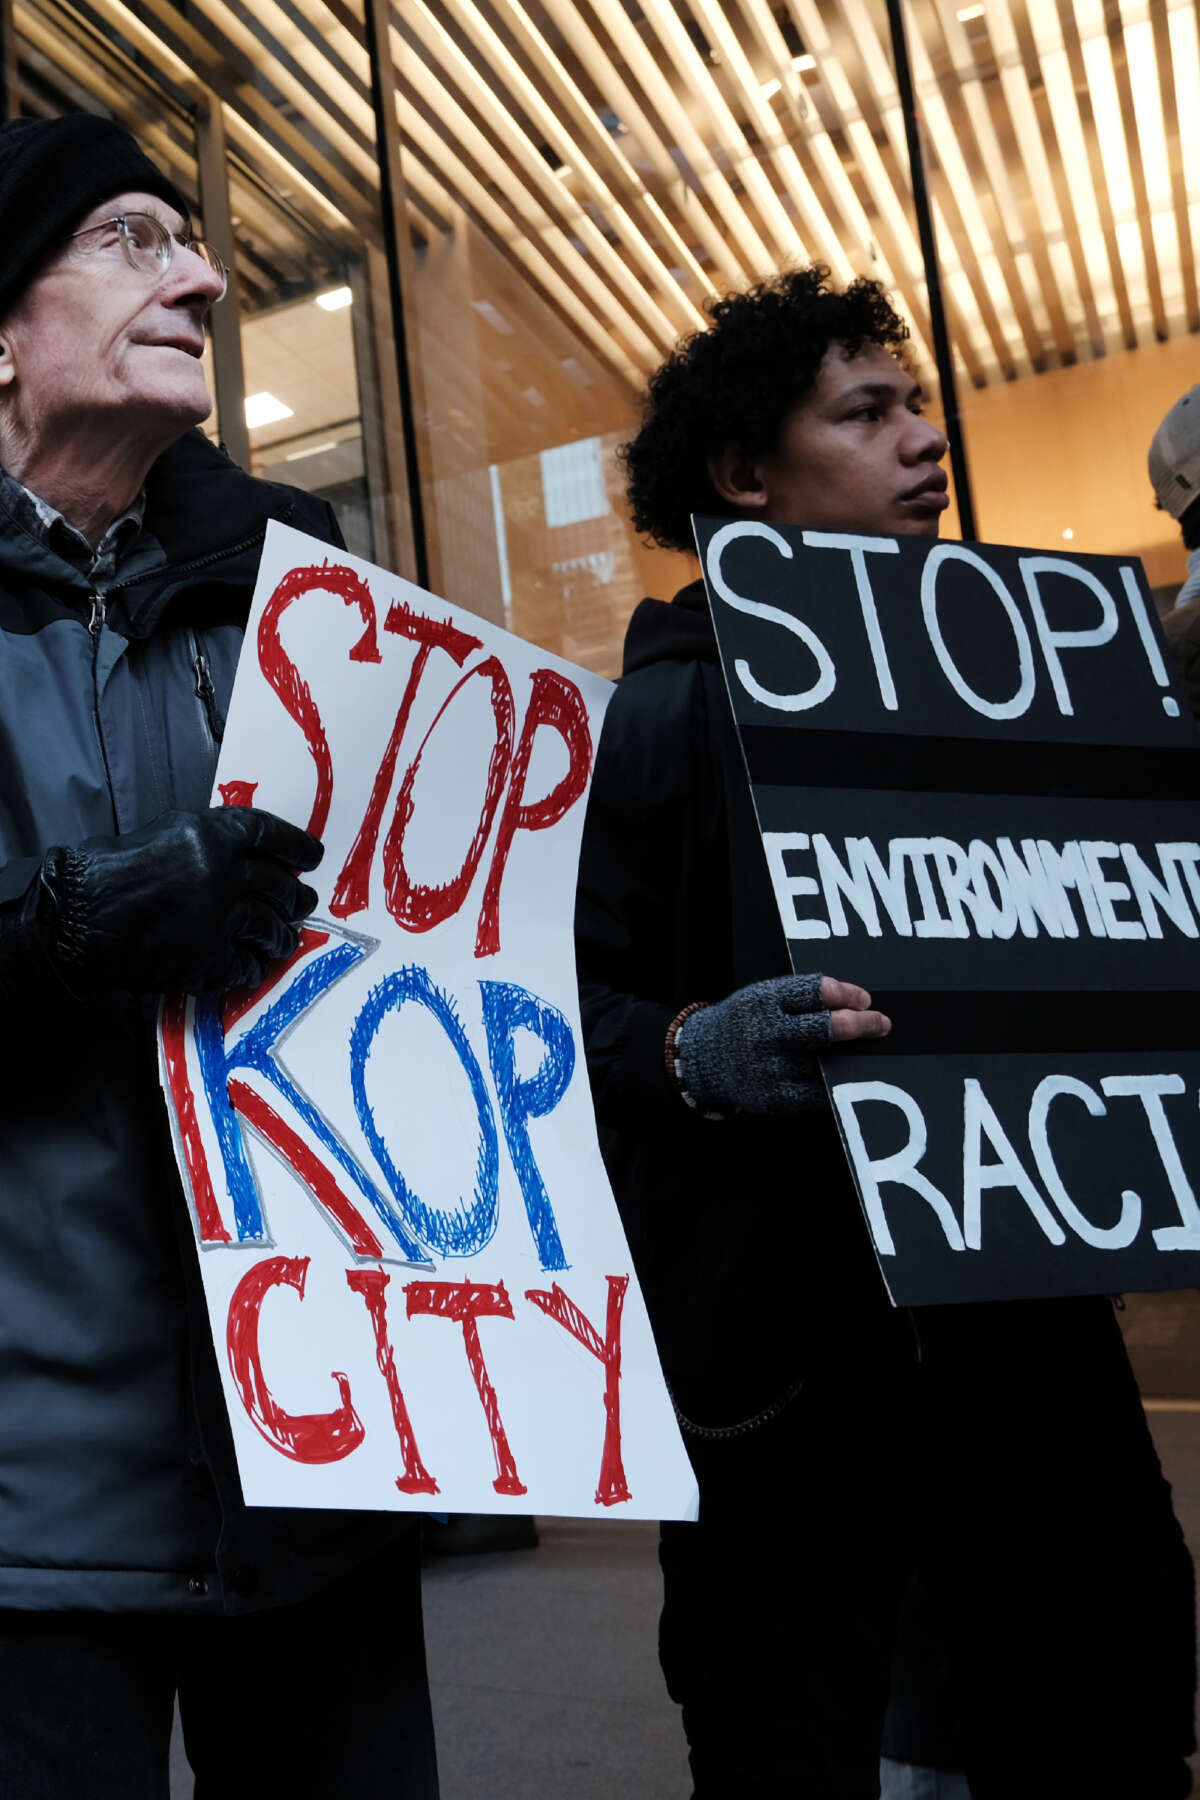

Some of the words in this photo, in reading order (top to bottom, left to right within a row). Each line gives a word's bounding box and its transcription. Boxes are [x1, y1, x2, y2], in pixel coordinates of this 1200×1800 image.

[707, 520, 1180, 720] STOP!
[217, 557, 592, 958] STOP
[761, 832, 1200, 940] ENVIRONMENT
[160, 920, 576, 1271] KOP
[227, 1256, 632, 1506] CITY
